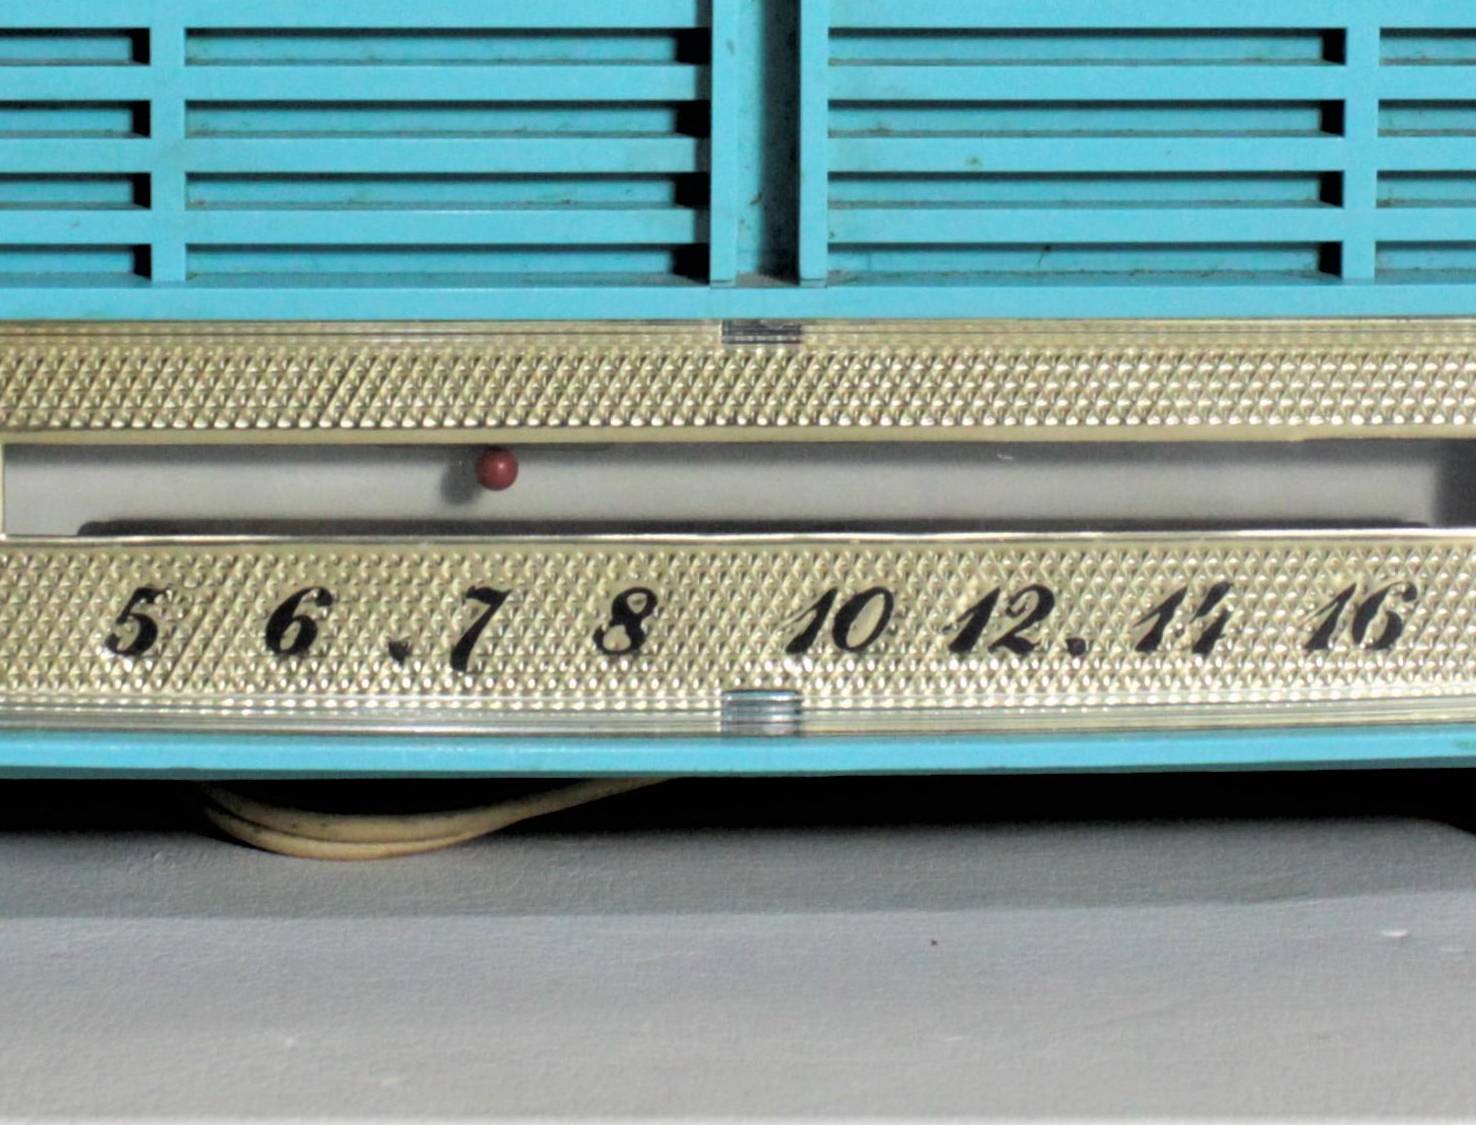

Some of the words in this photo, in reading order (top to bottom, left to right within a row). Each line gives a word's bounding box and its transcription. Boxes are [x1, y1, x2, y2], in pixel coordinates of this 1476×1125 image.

[106, 587, 172, 656] 5
[264, 586, 333, 655] 6
[593, 587, 659, 655] 8
[781, 585, 895, 654] 10
[1303, 580, 1419, 652] 16
